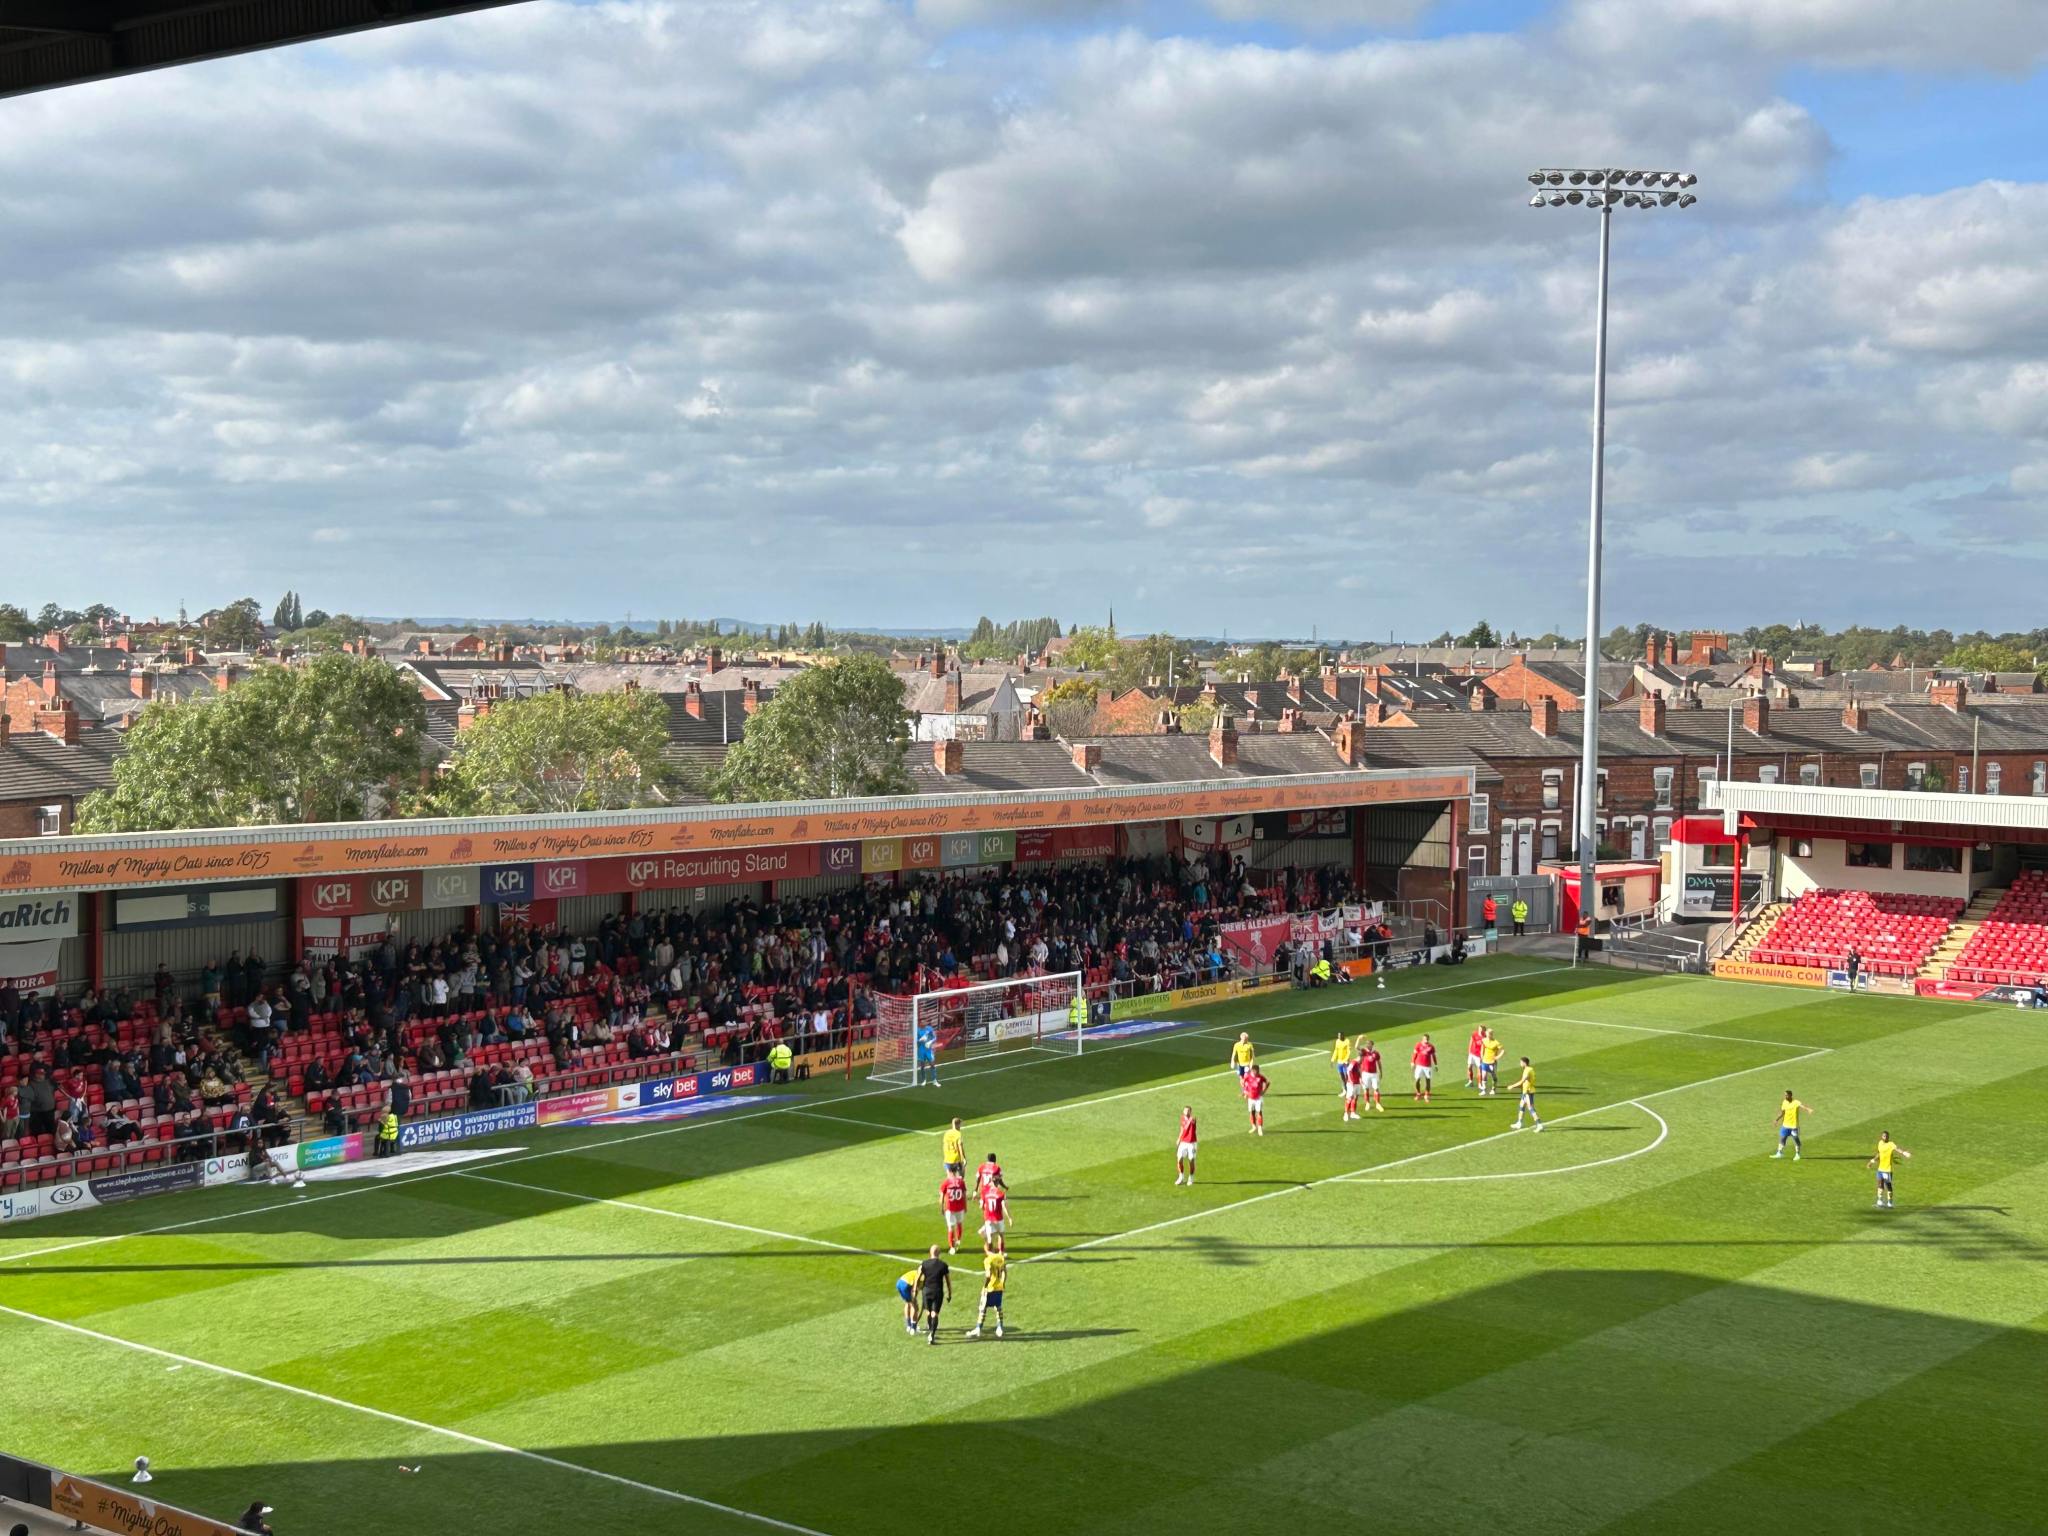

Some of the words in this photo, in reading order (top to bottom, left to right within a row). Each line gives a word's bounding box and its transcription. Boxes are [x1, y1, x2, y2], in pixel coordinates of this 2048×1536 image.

[927, 812, 948, 827] 1675
[493, 837, 527, 853] Millers
[529, 836, 541, 853] of
[542, 835, 578, 853] Mighty
[580, 834, 602, 849] Oats
[603, 833, 625, 846] since
[627, 829, 654, 847] 1675
[710, 824, 774, 840] Mornflake.com
[345, 843, 428, 862] Mornflake.com
[831, 847, 854, 864] KPi
[912, 841, 934, 858] KPi
[59, 860, 105, 878] Millers
[107, 857, 122, 877] of
[124, 856, 171, 877] Mighty
[173, 854, 202, 872] Oats
[204, 855, 234, 868] since
[236, 849, 271, 870] 1675
[630, 861, 658, 880] KPi
[664, 855, 740, 878] Recruiting
[745, 851, 788, 872] Stand
[436, 875, 468, 895] KPi
[495, 871, 524, 891] KPi
[548, 867, 576, 886] KPi
[317, 882, 351, 905] KPi
[377, 879, 410, 900] KPi
[1717, 964, 1823, 982] CCLTRAINING.COM
[819, 1047, 875, 1067] MORNLAKE
[712, 1072, 731, 1087] sky
[734, 1069, 753, 1083] bet
[653, 1083, 673, 1099] sky
[676, 1079, 697, 1093] bet
[418, 1118, 461, 1137] ENVIRO
[465, 1121, 495, 1136] 01270
[498, 1118, 515, 1130] 820
[518, 1113, 535, 1126] 426
[948, 1188, 963, 1201] 30
